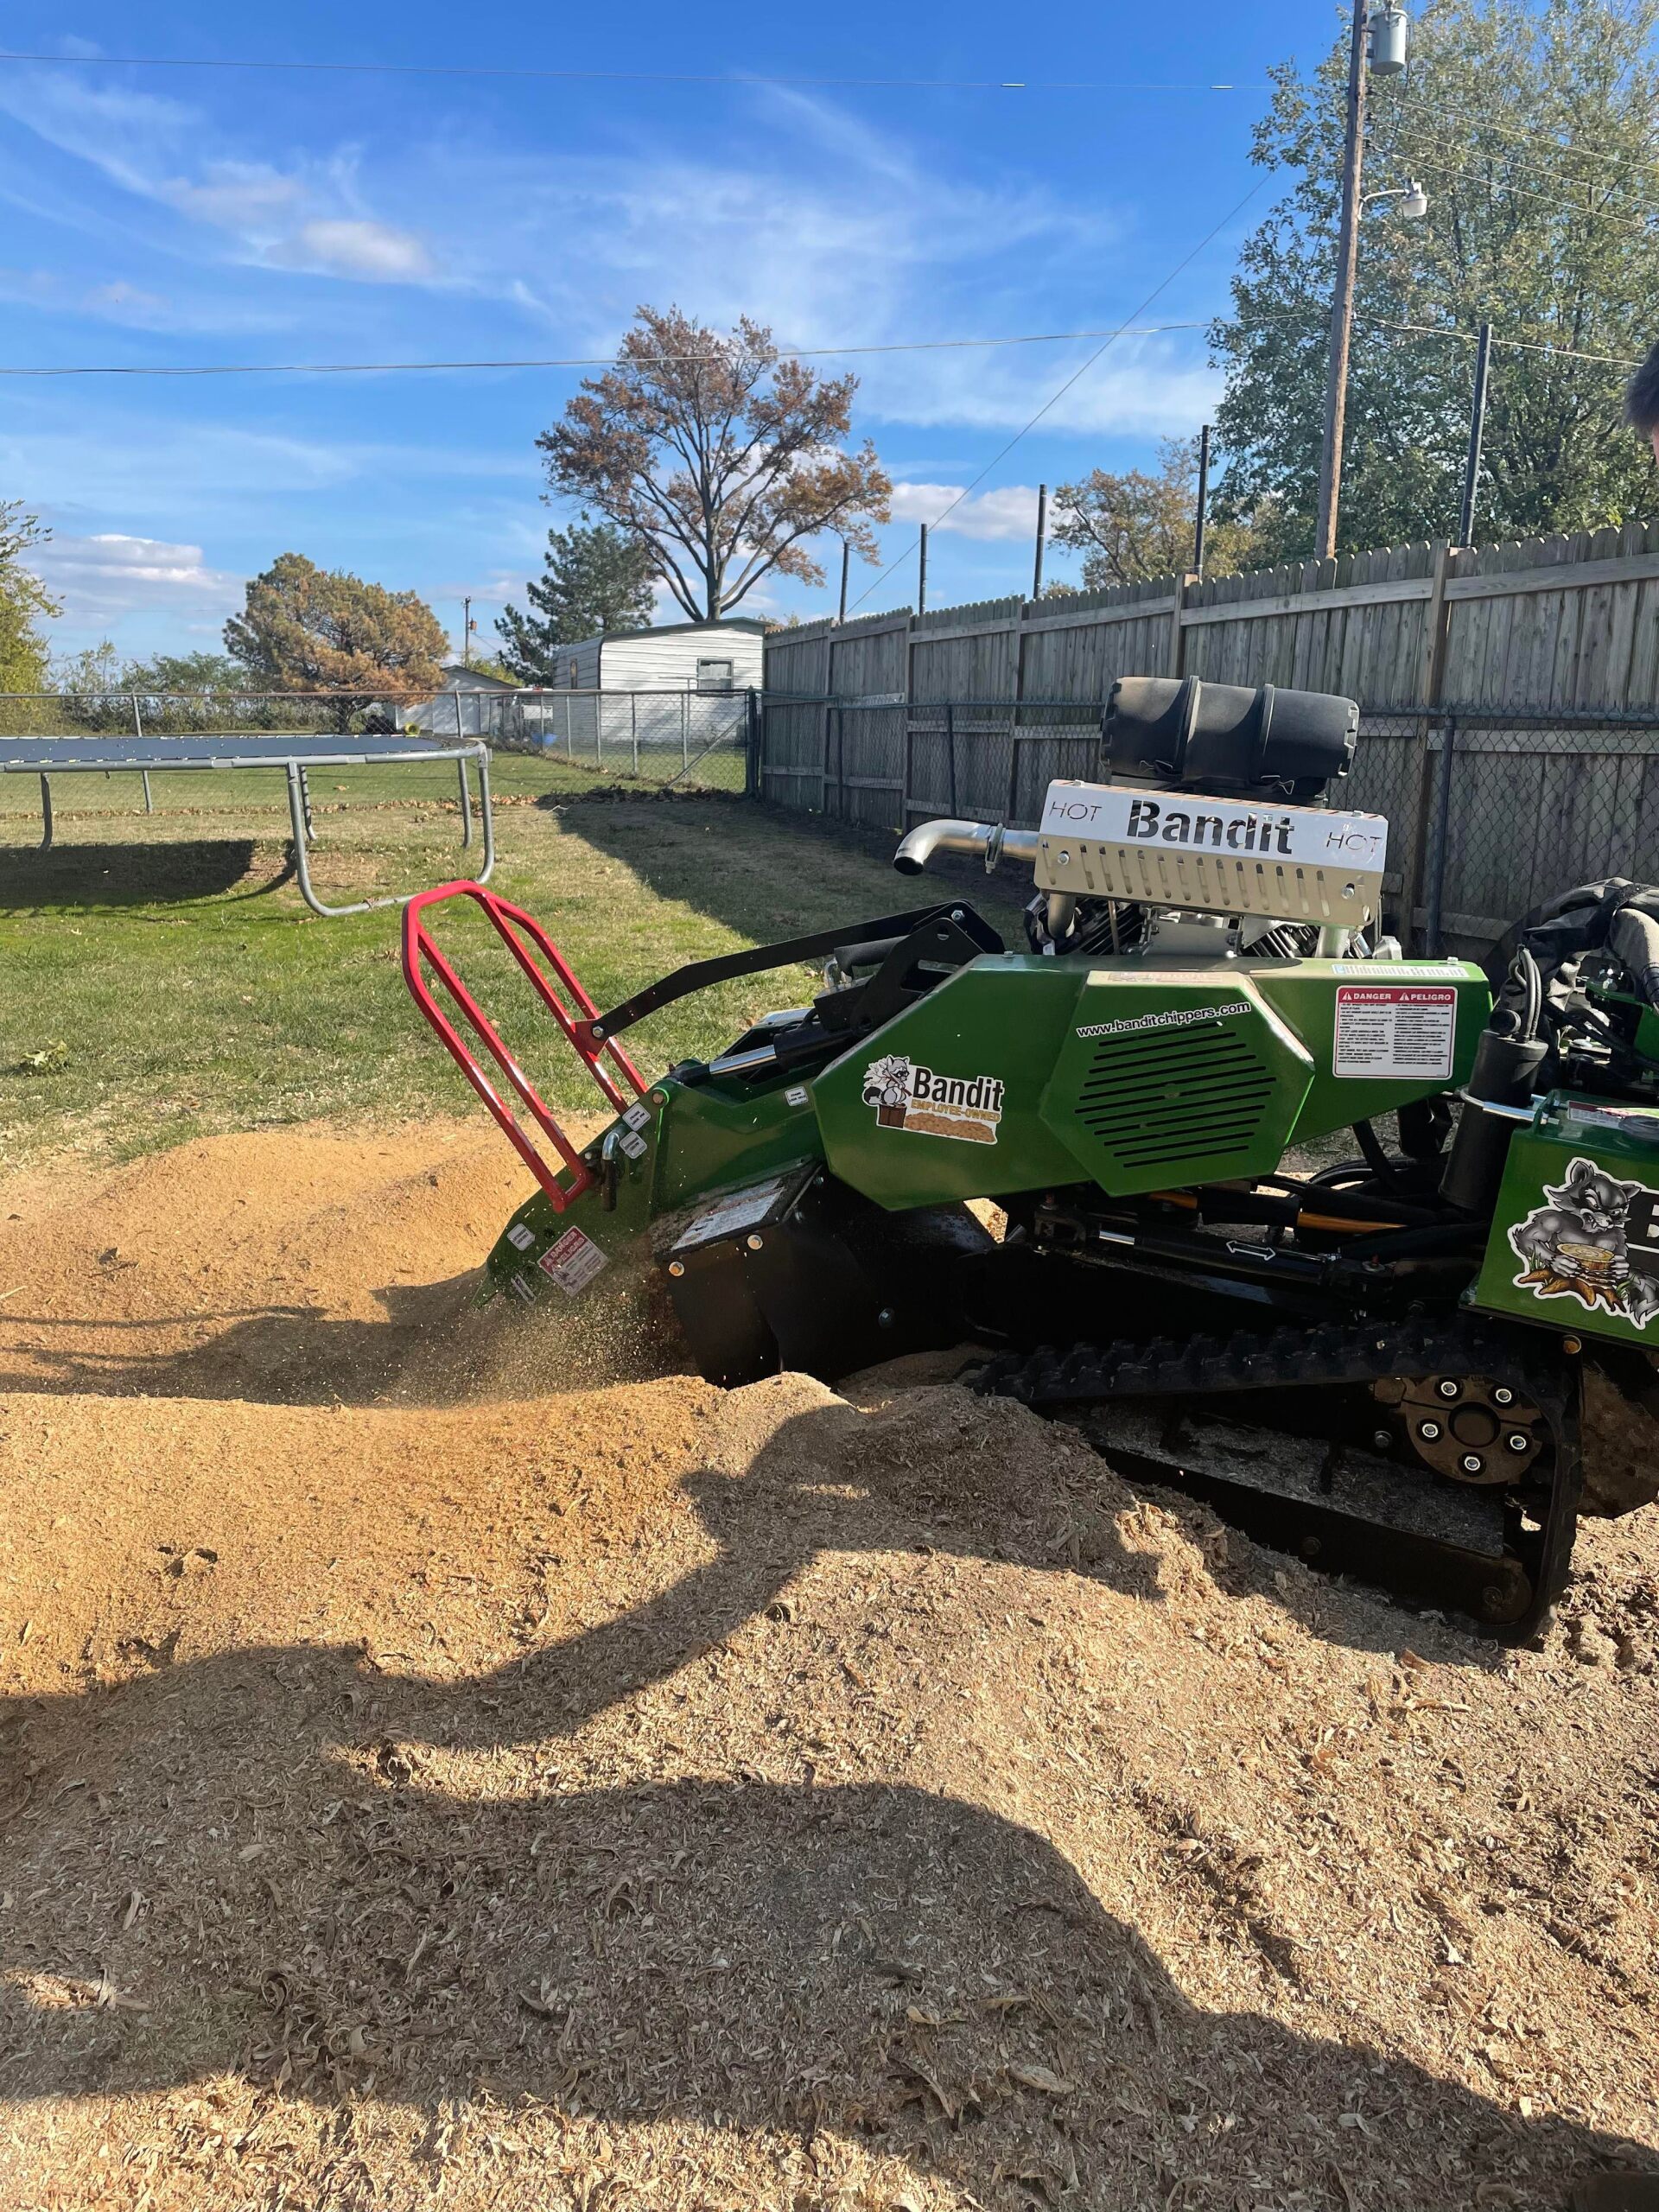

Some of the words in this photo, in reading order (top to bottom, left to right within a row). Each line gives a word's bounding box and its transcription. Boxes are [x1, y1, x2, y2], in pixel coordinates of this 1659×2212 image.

[1049, 801, 1103, 821] HOT
[1127, 799, 1295, 854] Bandit
[1325, 831, 1382, 853] HOT
[1077, 1001, 1251, 1037] www.banditchippers.com
[912, 1067, 1003, 1112] Bandit
